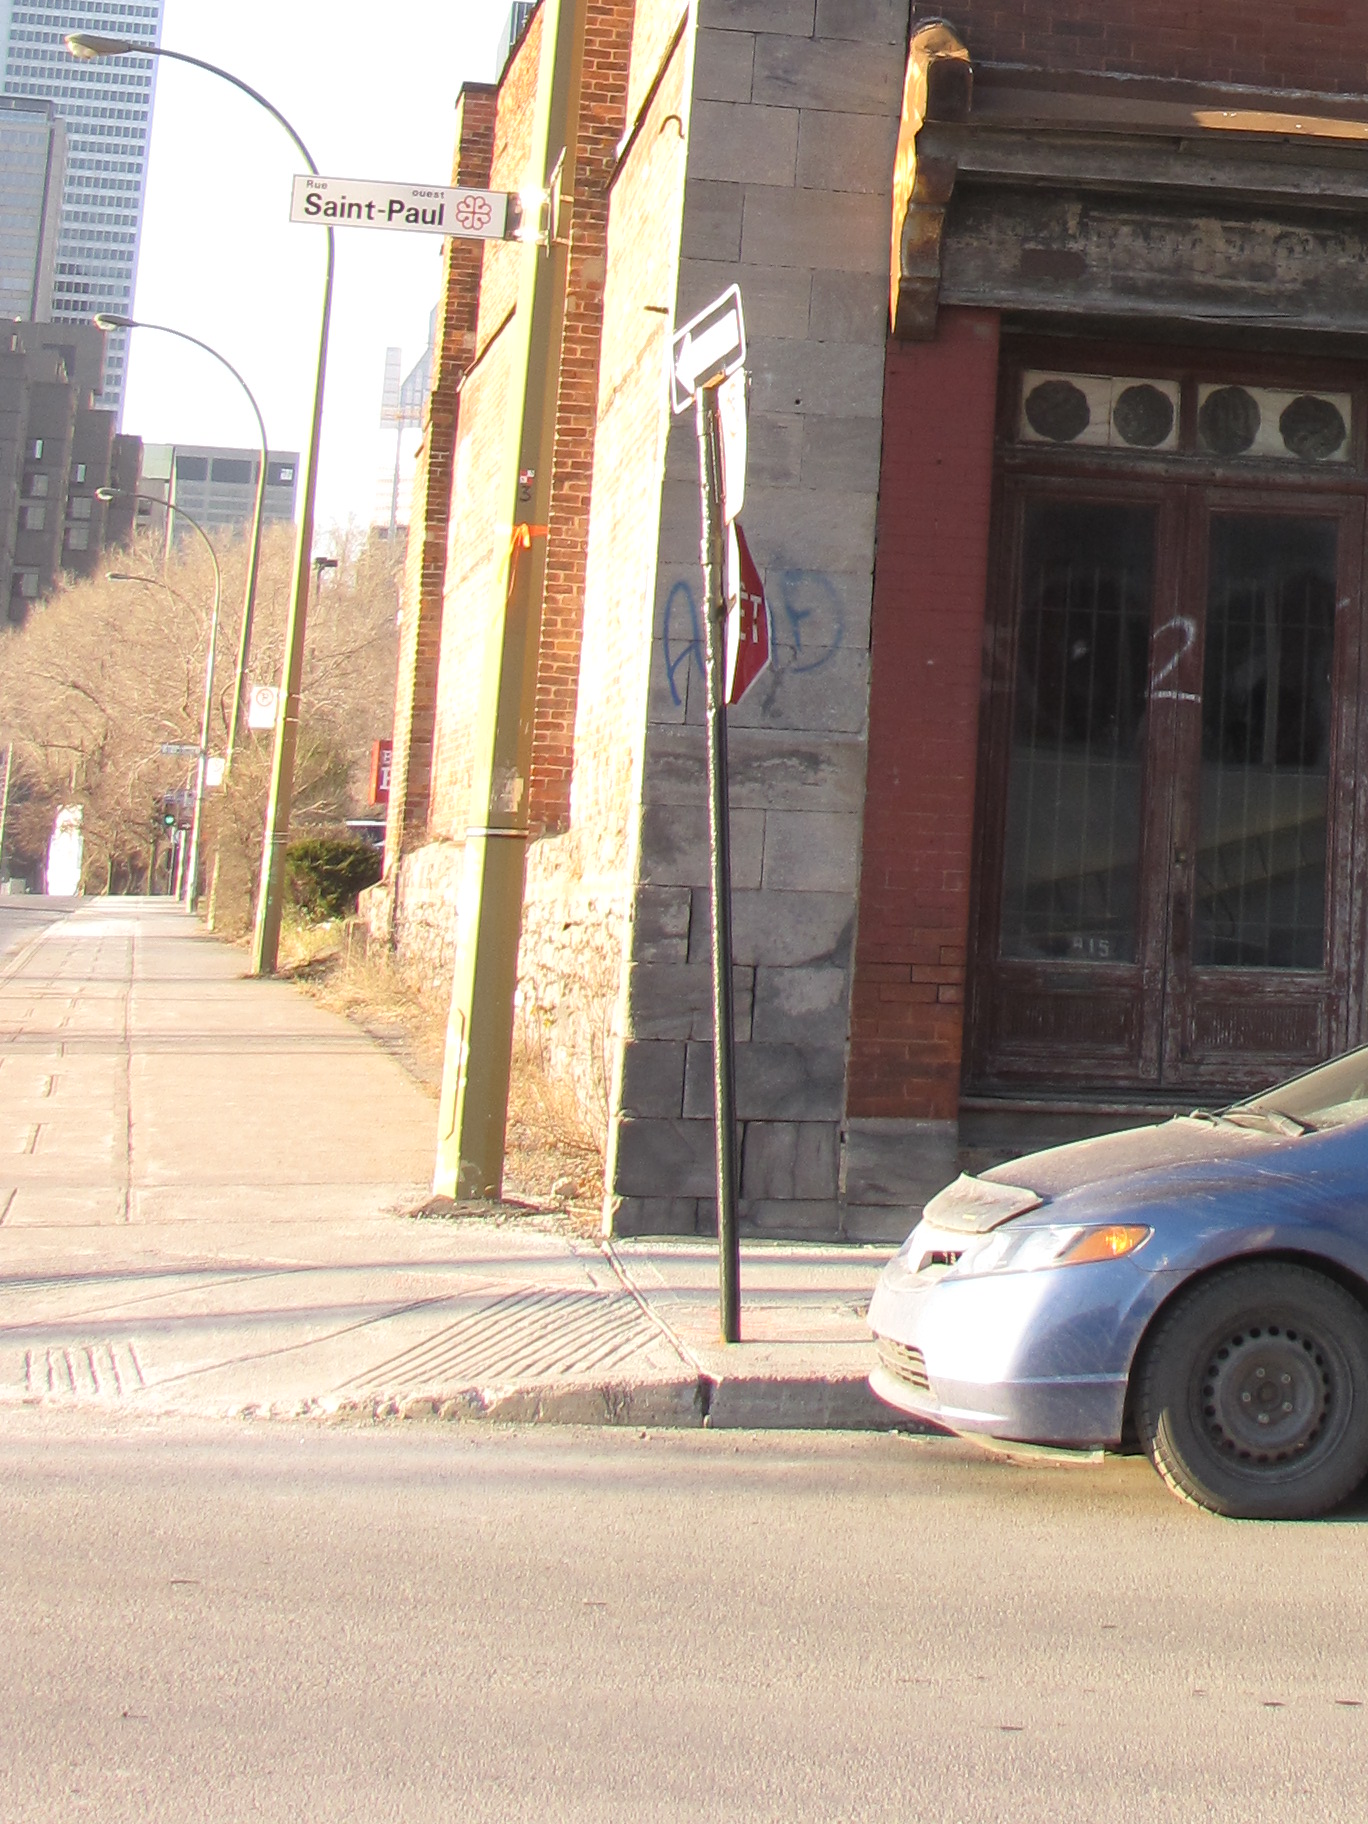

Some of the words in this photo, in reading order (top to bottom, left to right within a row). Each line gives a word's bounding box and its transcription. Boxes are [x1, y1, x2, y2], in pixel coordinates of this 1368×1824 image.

[306, 179, 328, 190] Rue
[411, 189, 445, 199] ouest
[304, 192, 446, 226] Saint-Paul
